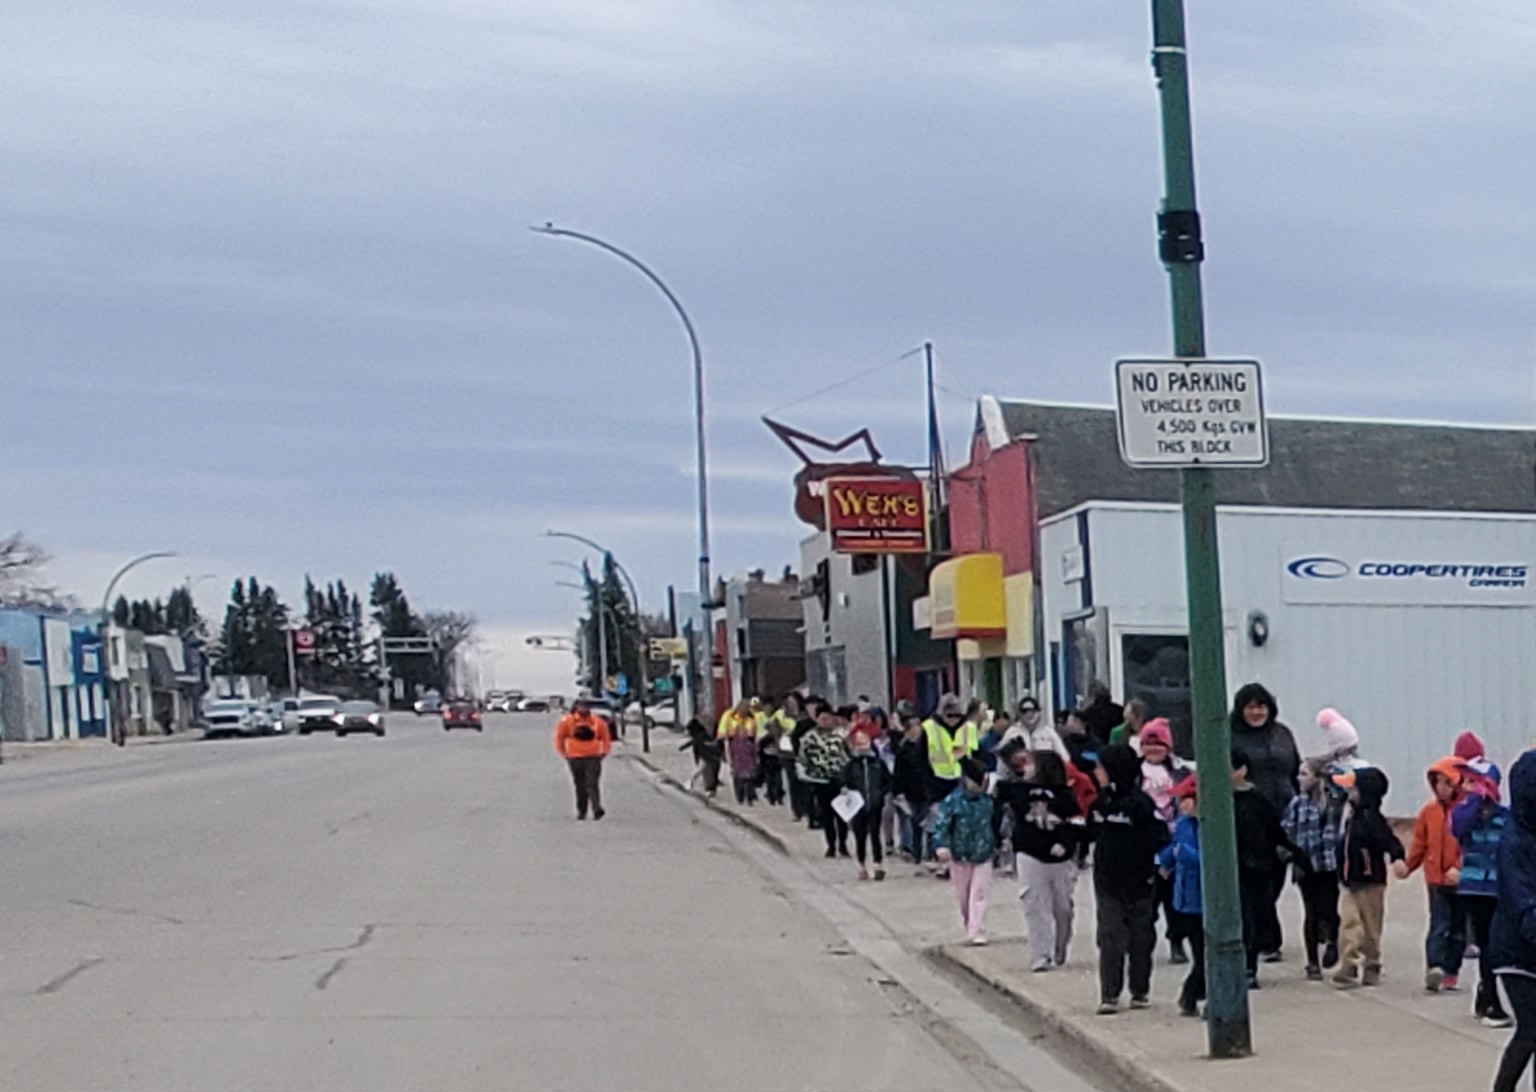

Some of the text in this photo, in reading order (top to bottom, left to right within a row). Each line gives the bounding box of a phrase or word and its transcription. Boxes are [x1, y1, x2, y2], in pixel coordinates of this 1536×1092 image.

[1132, 371, 1247, 393] NO PARKING
[1141, 399, 1242, 414] VEHICLES OVER
[1157, 440, 1232, 454] THIS BLOCK
